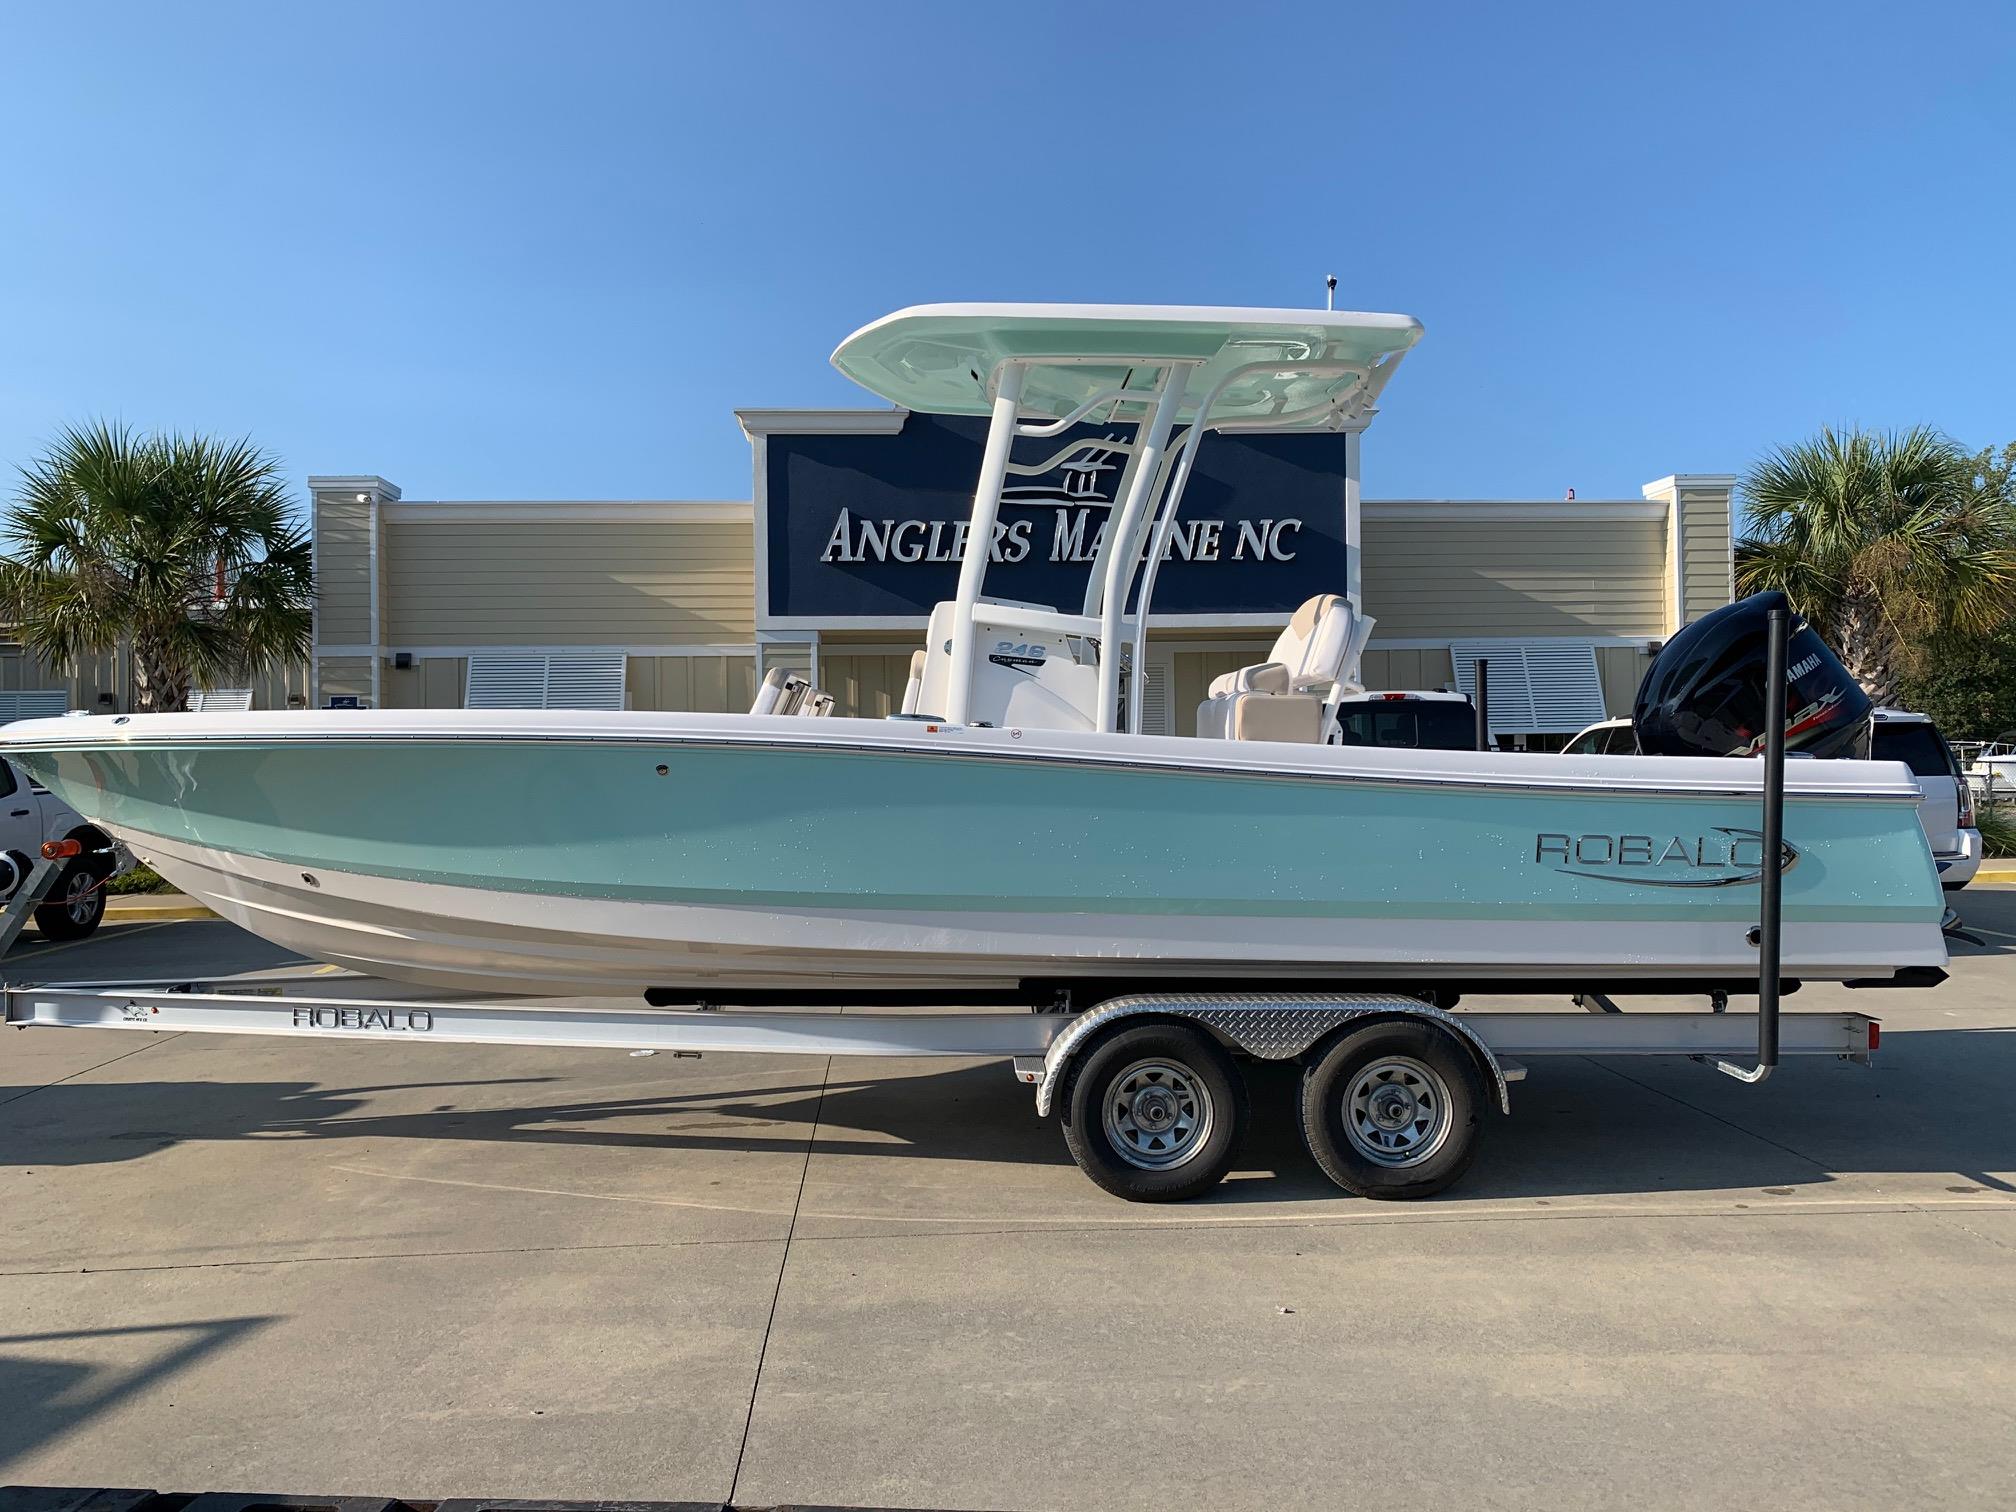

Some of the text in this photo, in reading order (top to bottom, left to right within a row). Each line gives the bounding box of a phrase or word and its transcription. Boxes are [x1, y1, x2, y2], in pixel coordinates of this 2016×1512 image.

[1049, 509, 1223, 561] MAINE
[1231, 518, 1302, 561] NC
[995, 641, 1046, 657] 246
[1786, 652, 1822, 685] AMAHA
[1536, 833, 1764, 868] ROBALO
[292, 1006, 432, 1032] ROBALO
